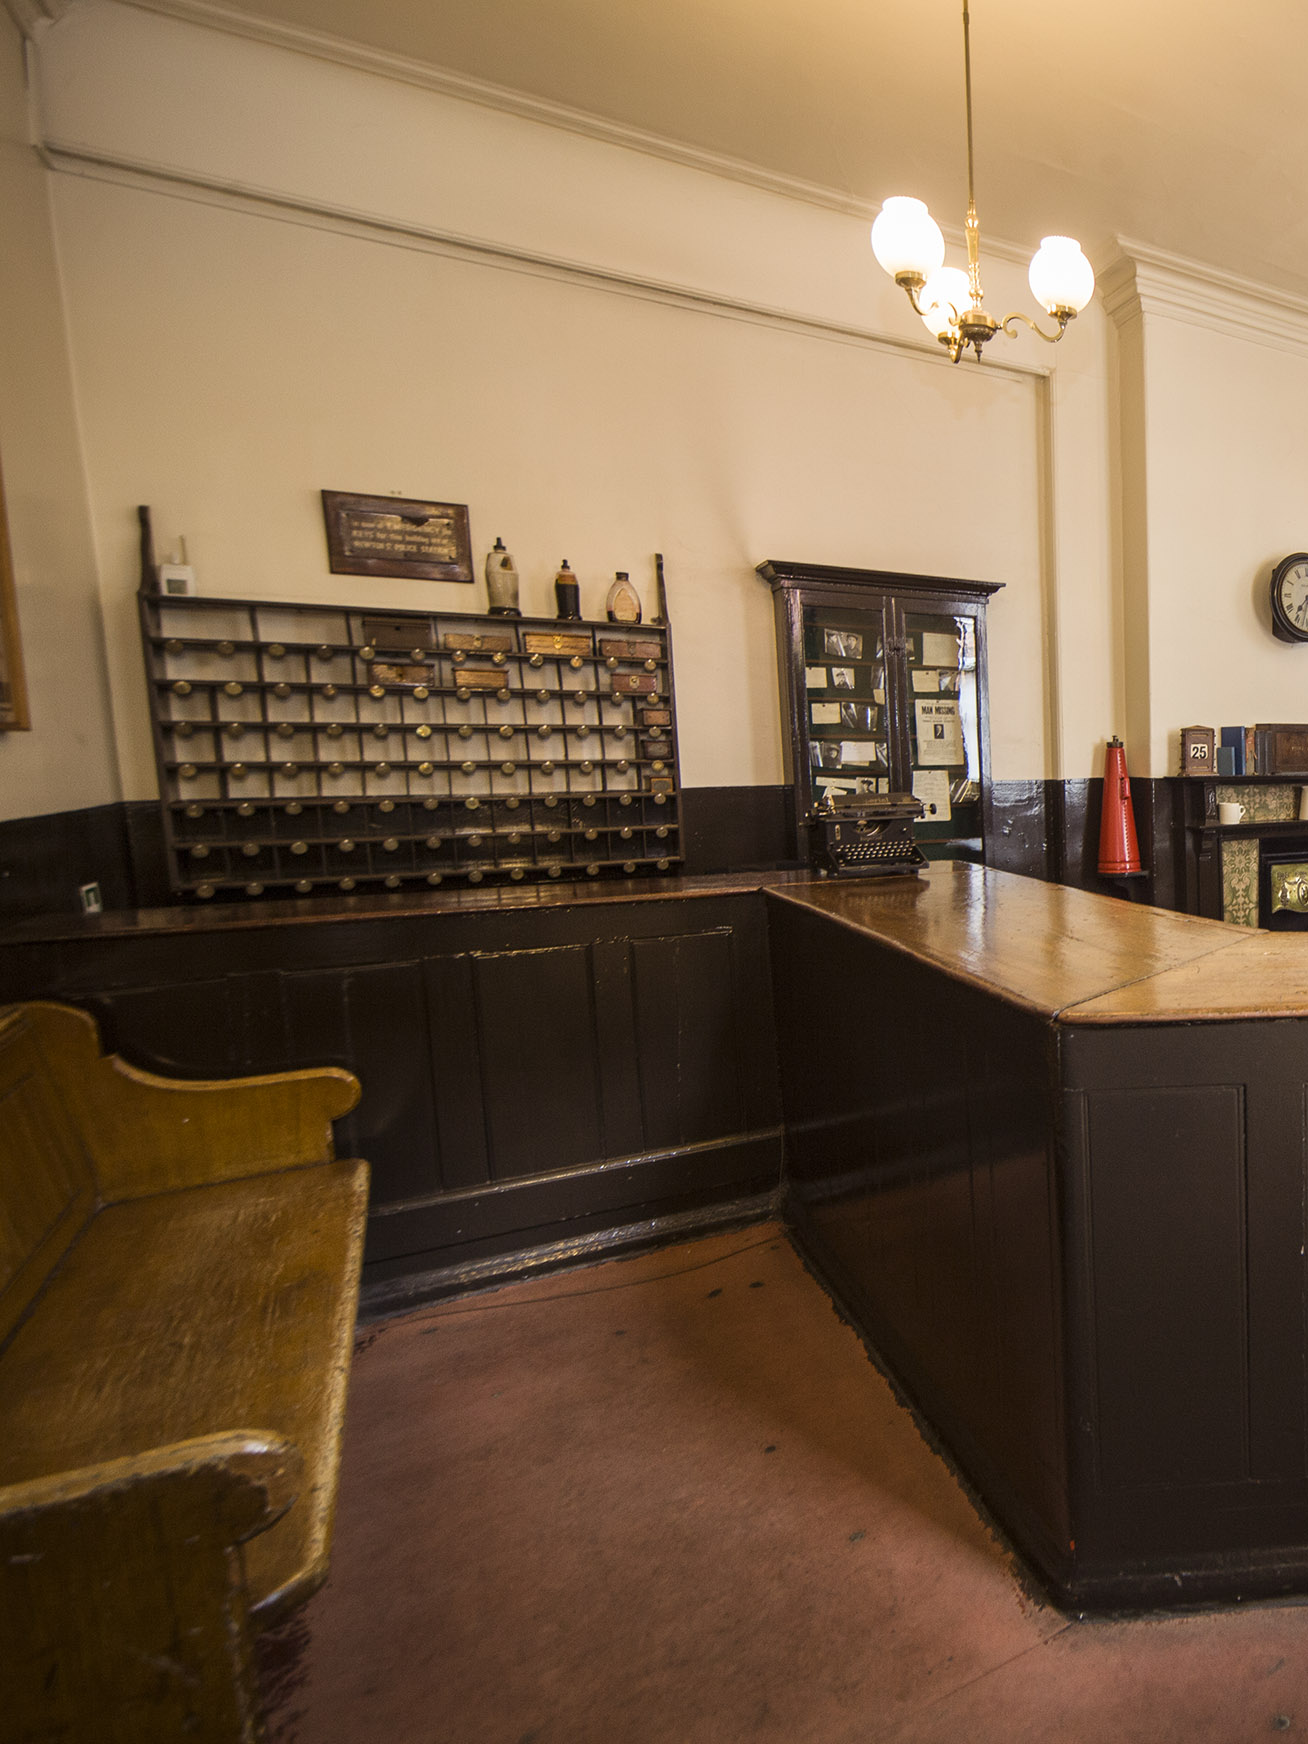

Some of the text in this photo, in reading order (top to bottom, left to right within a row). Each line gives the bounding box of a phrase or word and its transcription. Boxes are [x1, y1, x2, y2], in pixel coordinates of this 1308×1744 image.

[921, 705, 956, 716] MAN MISSING
[1192, 745, 1207, 759] 25
